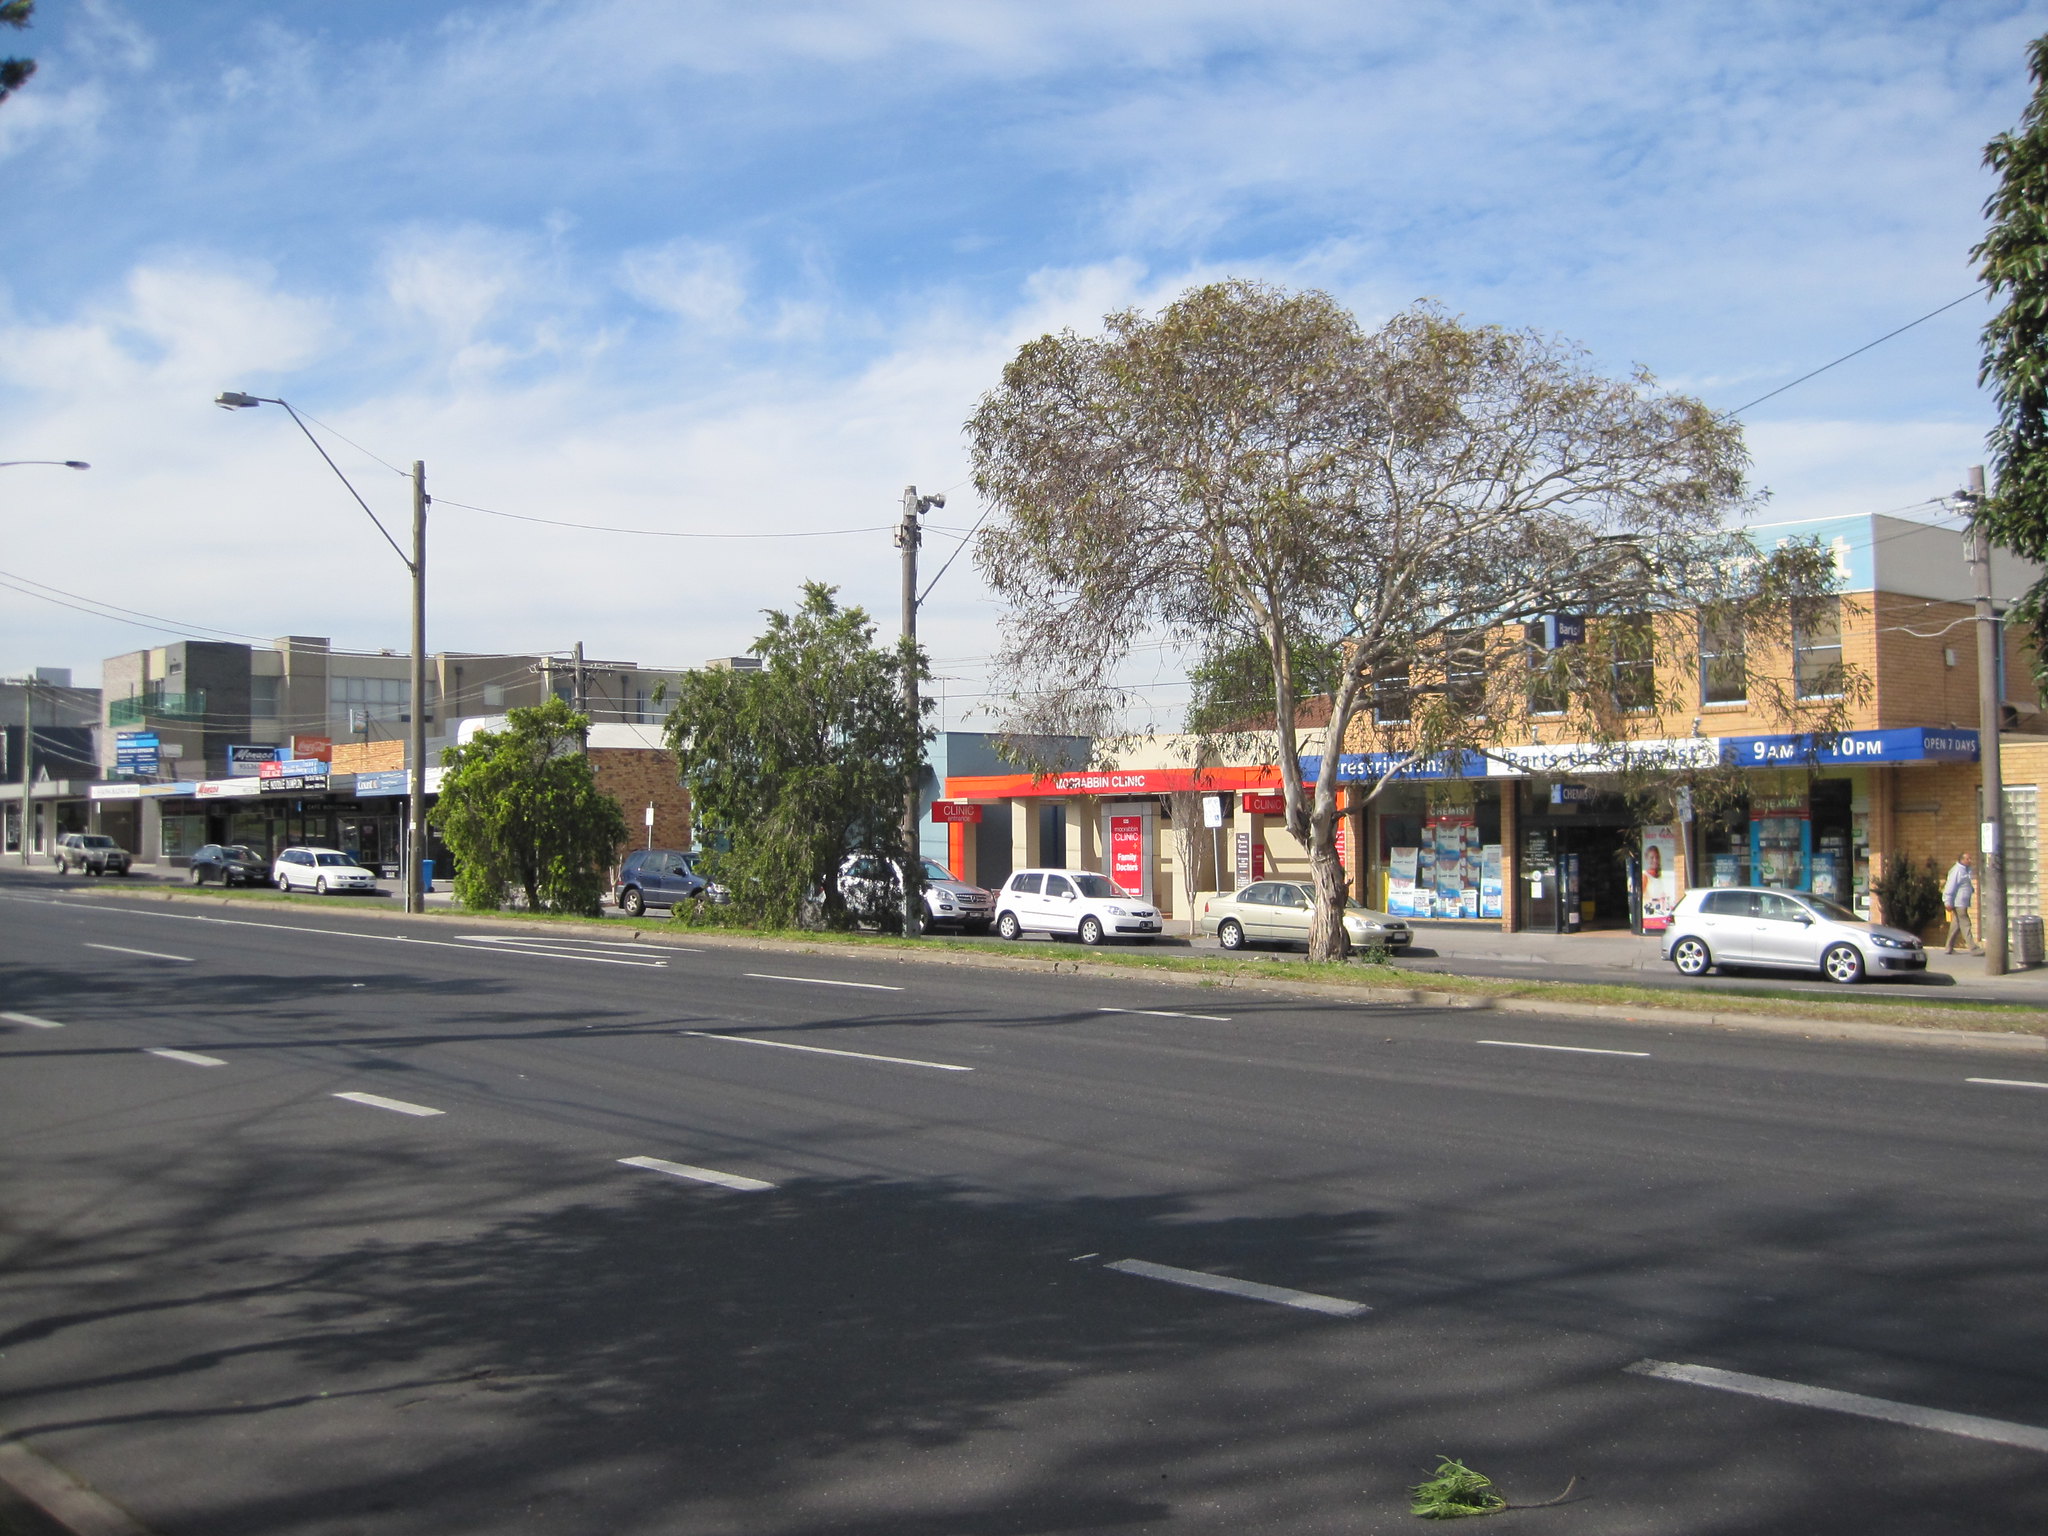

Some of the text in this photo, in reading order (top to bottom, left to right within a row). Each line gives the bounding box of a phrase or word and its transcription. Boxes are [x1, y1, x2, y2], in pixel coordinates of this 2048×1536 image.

[1923, 737, 1977, 752] OPEN 7 DAYS
[233, 749, 274, 760] Monaco
[1111, 775, 1145, 787] CLINIC
[1253, 799, 1283, 810] CLINIC
[943, 805, 975, 816] CLINIC
[1114, 832, 1139, 841] CLINIC
[1117, 853, 1137, 862] Family
